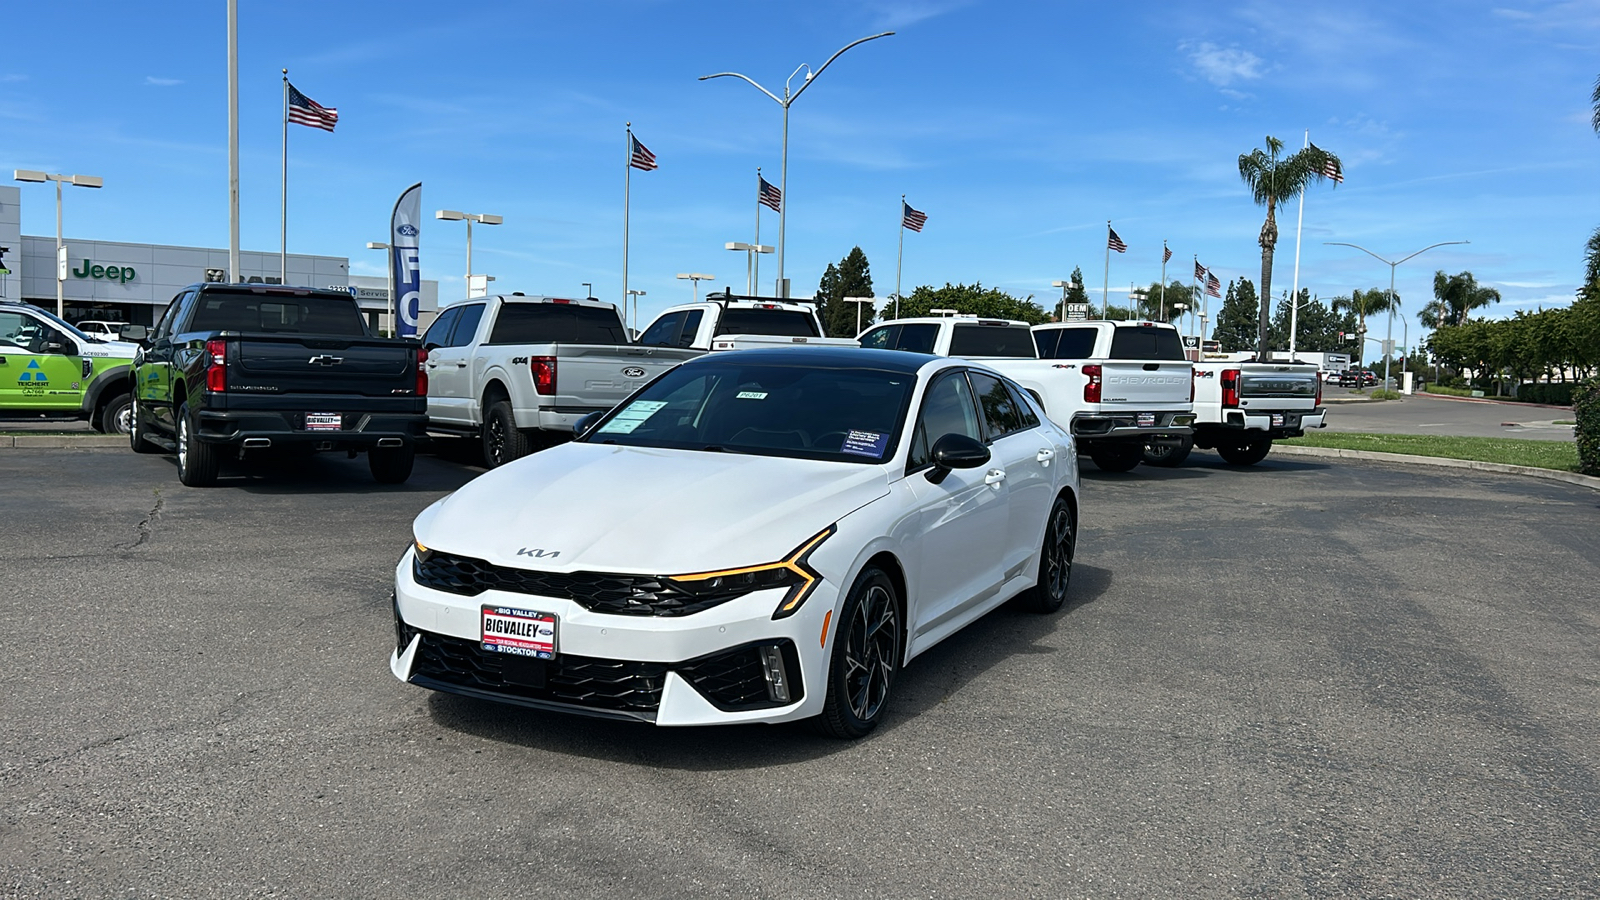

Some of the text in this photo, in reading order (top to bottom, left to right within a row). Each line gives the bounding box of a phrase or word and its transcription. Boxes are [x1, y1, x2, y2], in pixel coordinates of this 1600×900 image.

[73, 259, 135, 283] Jeep
[1067, 304, 1087, 312] OEM
[1109, 376, 1187, 386] CHEVROLET
[516, 547, 561, 559] KIA
[498, 607, 538, 618] BIG VALLEY
[485, 618, 540, 638] BIGVALLEY
[497, 645, 537, 657] STOCKTON
